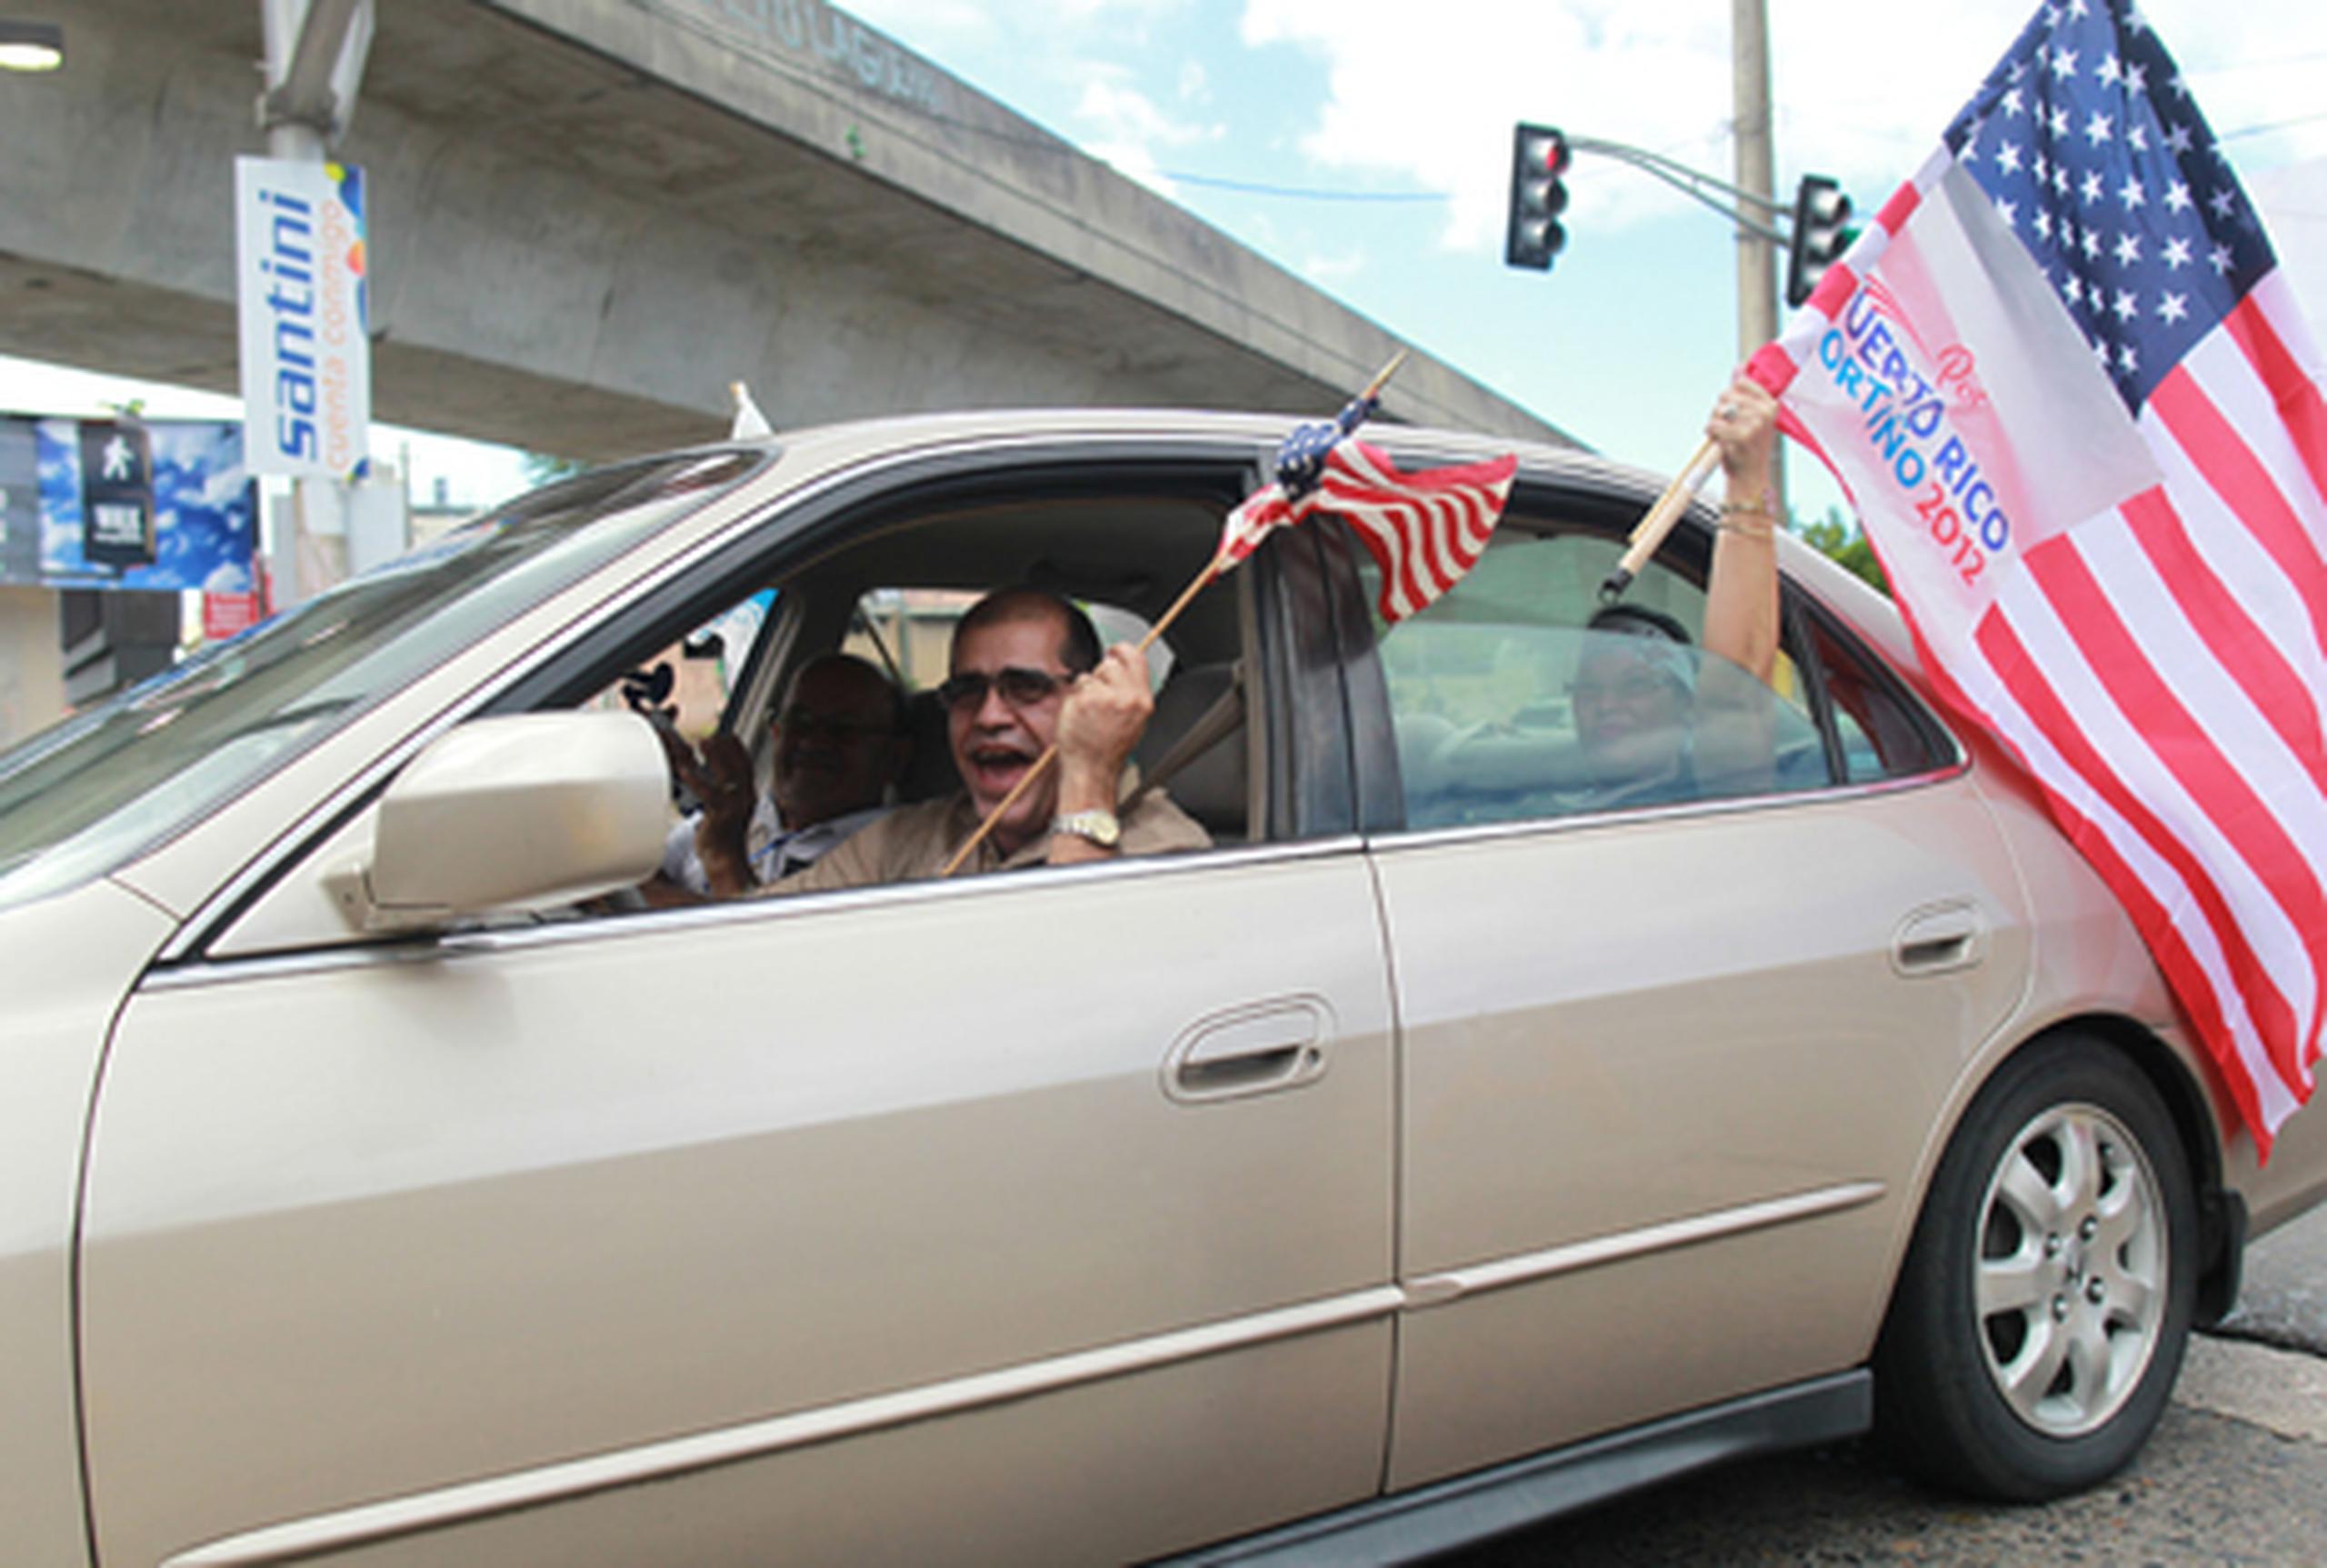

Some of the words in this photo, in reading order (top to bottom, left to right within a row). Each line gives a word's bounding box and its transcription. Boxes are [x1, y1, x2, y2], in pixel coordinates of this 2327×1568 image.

[258, 189, 317, 462] santini
[321, 199, 349, 345] conmigo
[323, 356, 349, 470] cuenta
[1914, 481, 1987, 587] 2012
[1933, 434, 2010, 552] RICO
